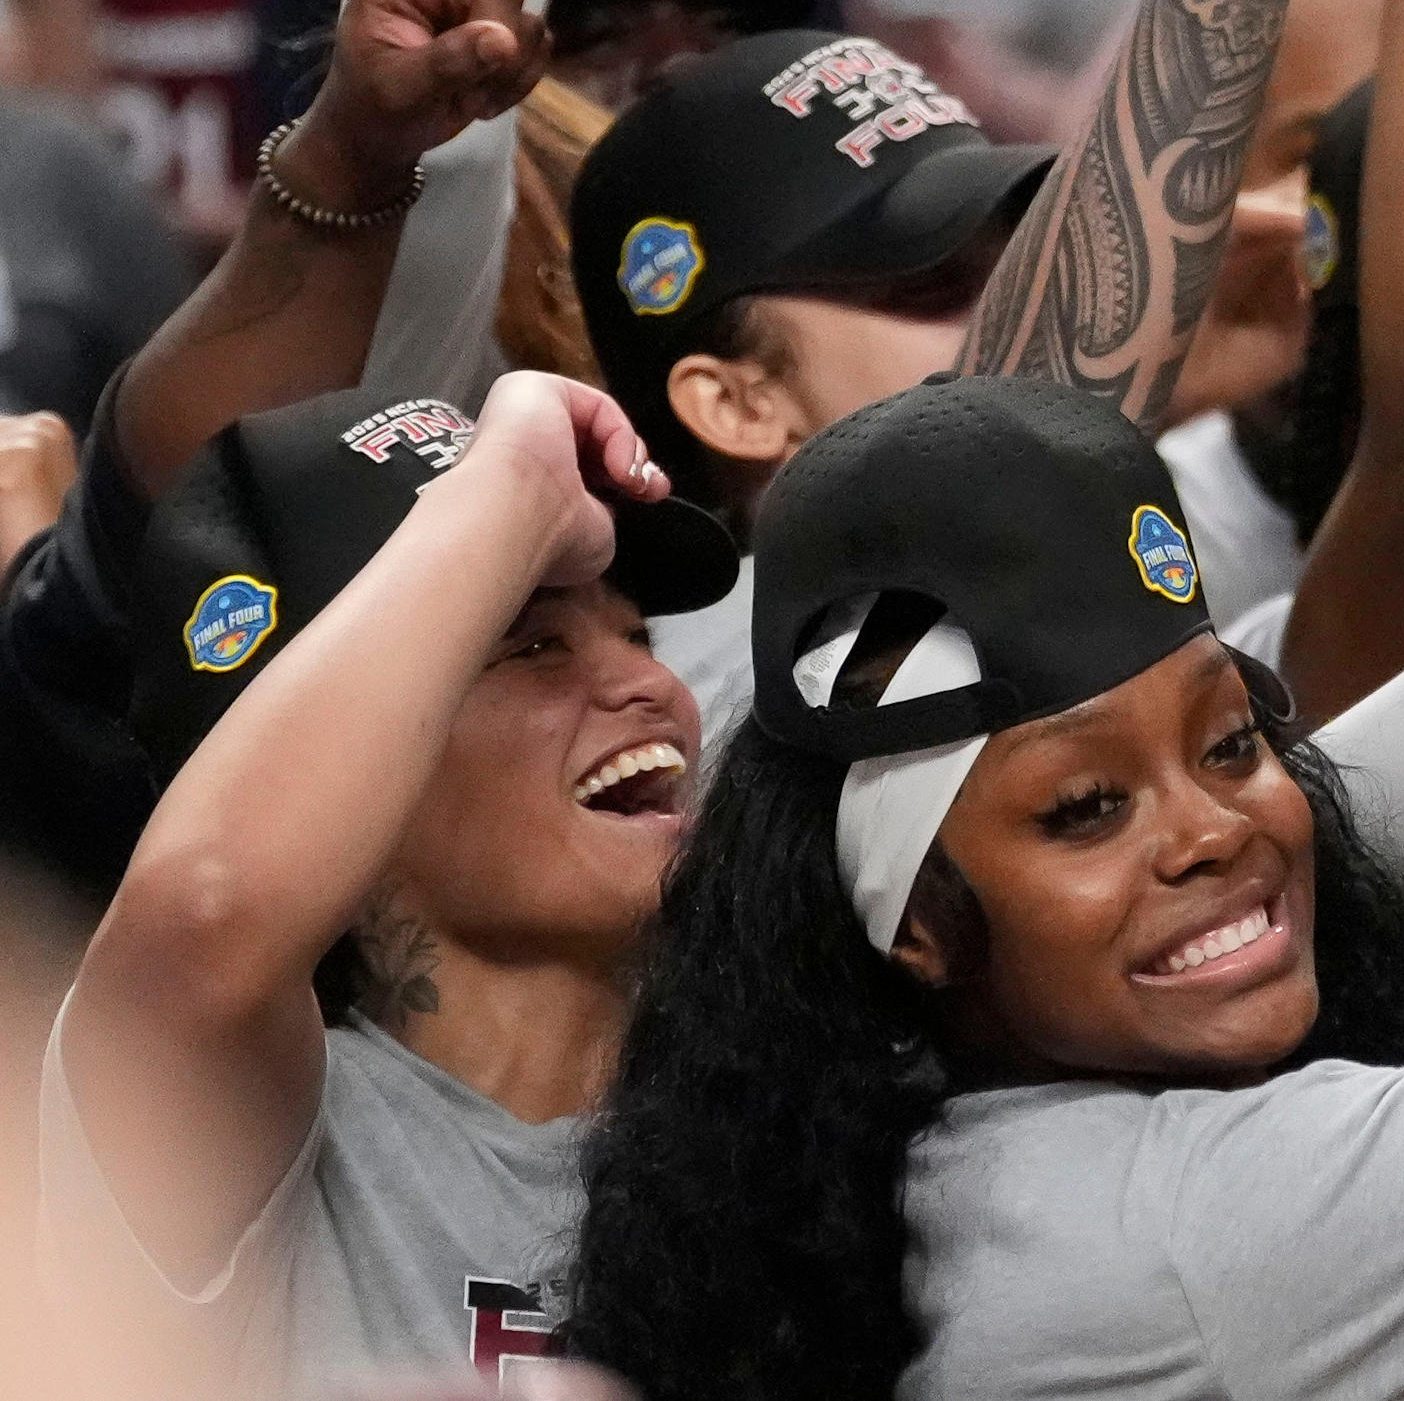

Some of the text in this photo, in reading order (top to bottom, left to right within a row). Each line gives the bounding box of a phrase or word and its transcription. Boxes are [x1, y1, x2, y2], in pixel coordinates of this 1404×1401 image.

[350, 408, 476, 464] FIN
[193, 604, 265, 651] FINAL FOUR
